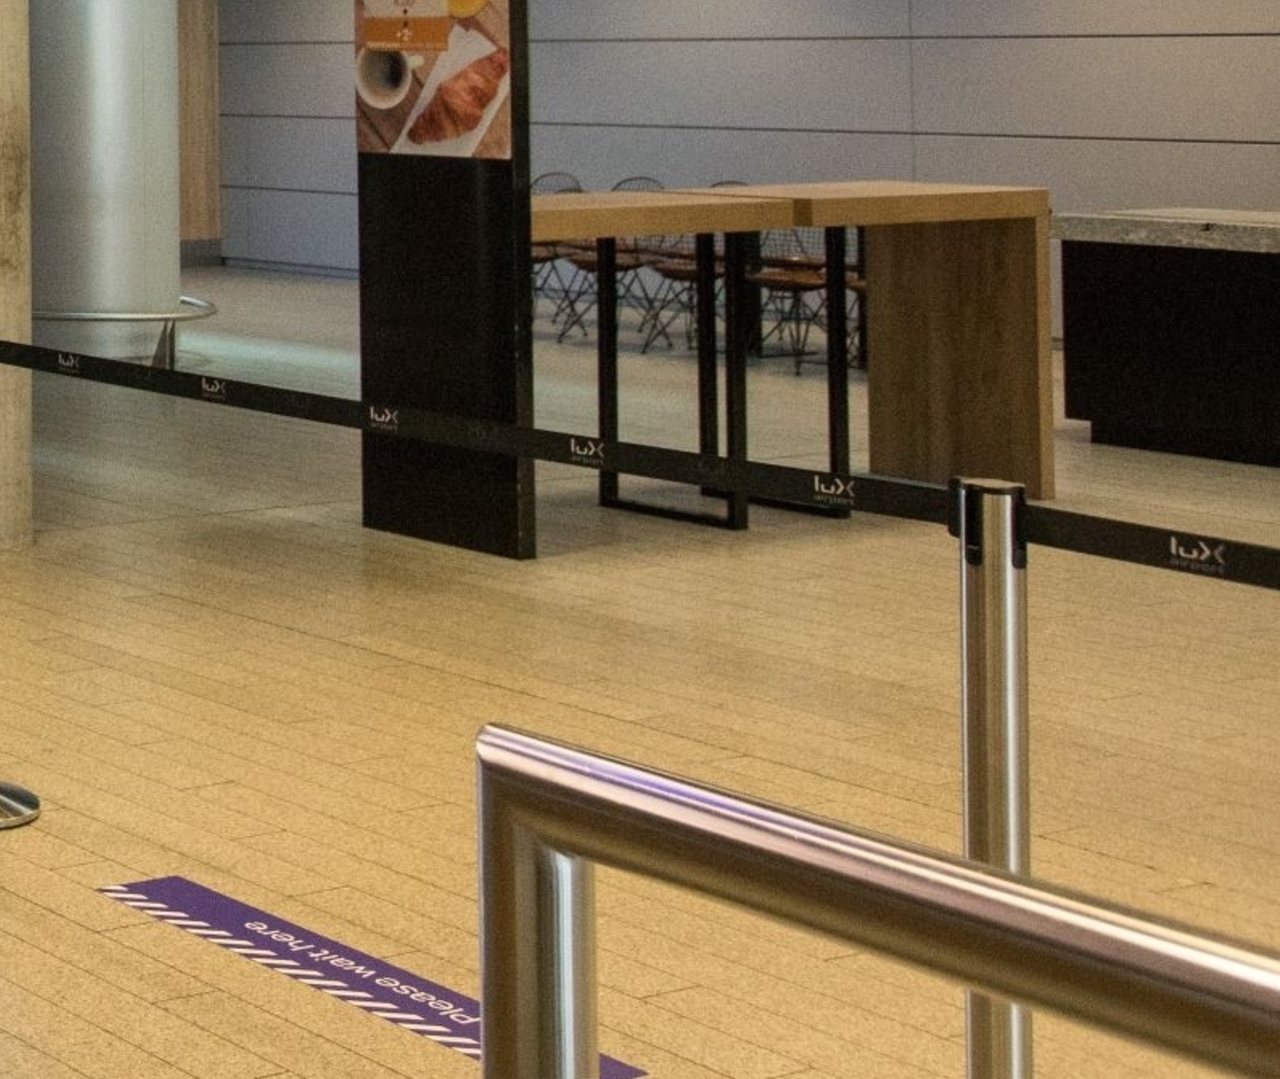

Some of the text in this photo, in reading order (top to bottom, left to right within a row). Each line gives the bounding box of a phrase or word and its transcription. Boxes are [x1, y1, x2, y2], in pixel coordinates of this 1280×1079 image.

[243, 920, 481, 1025] Please wait here
